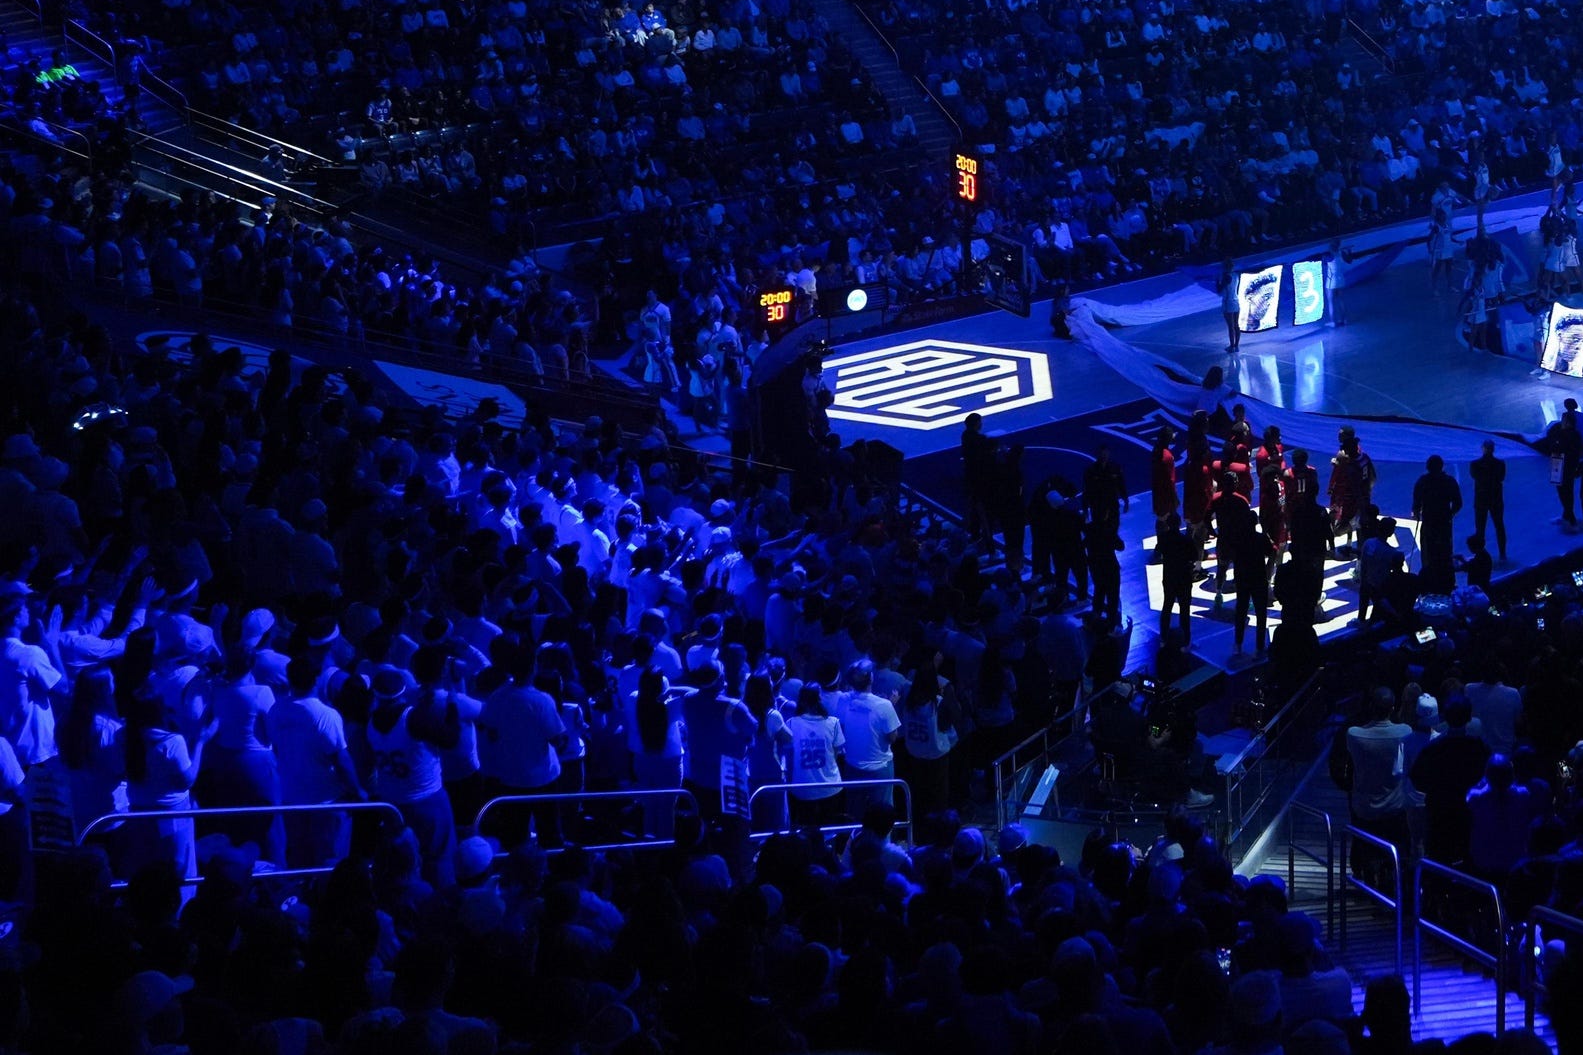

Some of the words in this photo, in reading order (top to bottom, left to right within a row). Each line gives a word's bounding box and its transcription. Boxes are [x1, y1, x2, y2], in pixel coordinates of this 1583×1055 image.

[956, 154, 977, 175] 20:00
[959, 171, 975, 201] 30
[760, 291, 791, 306] 20:00
[1299, 270, 1320, 313] 3
[767, 305, 784, 321] 30
[800, 749, 827, 769] 25
